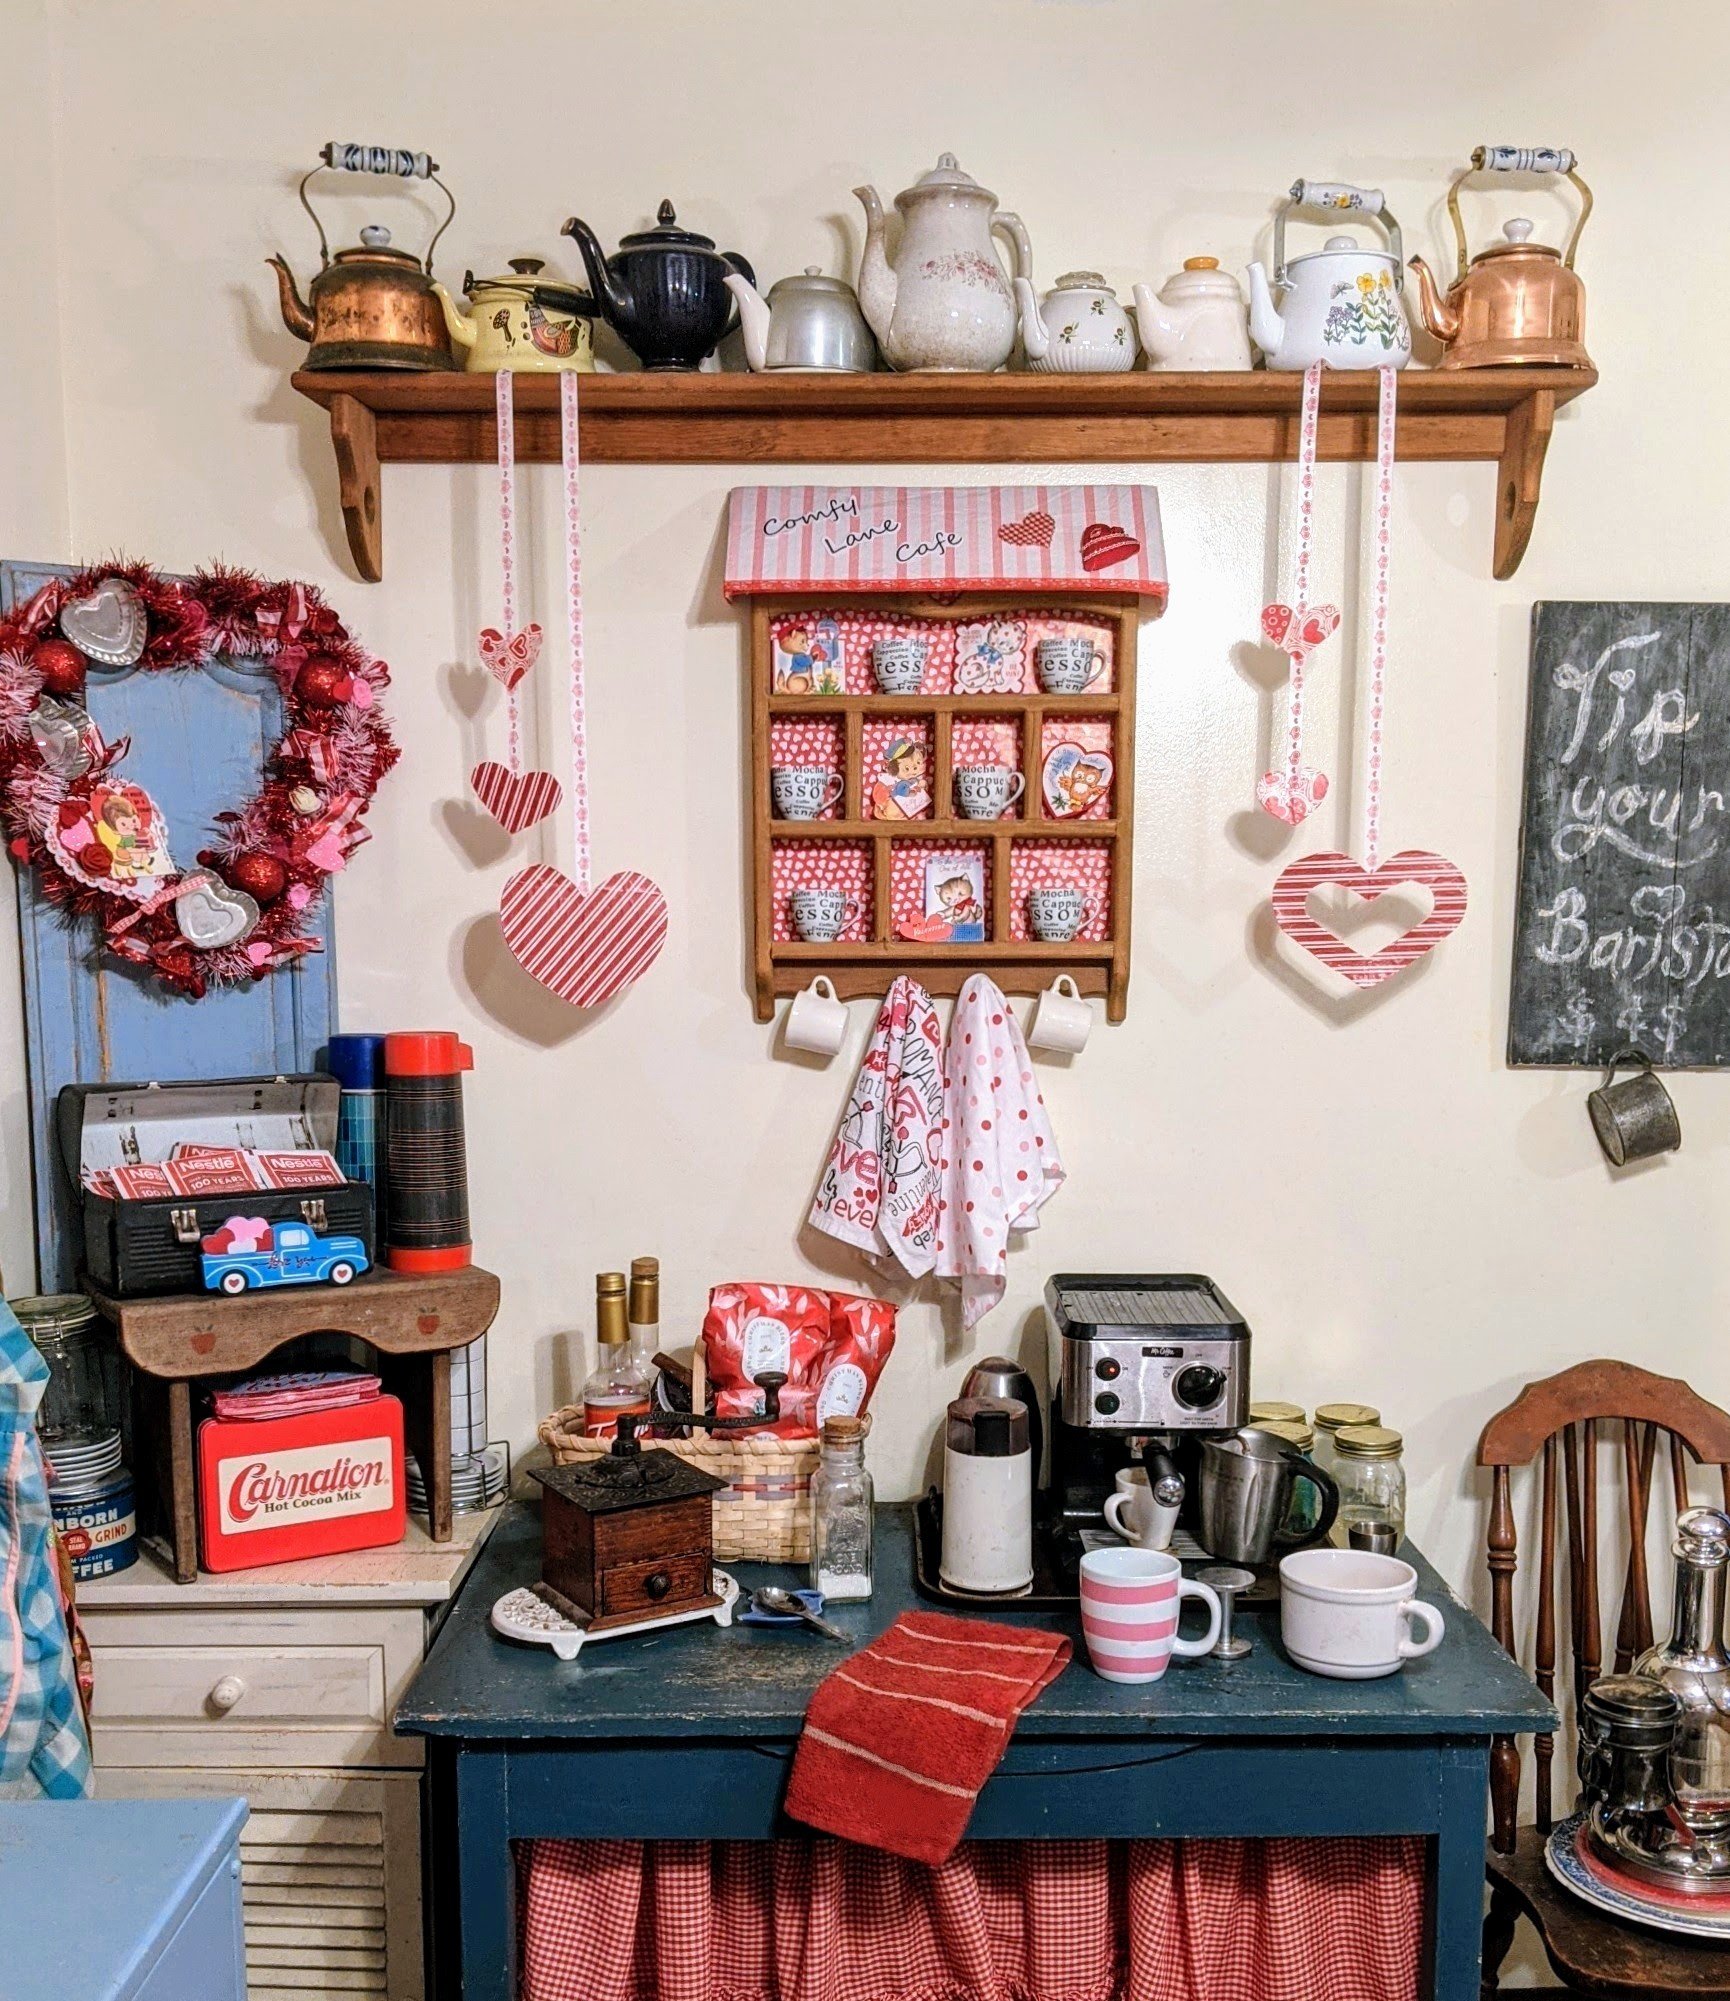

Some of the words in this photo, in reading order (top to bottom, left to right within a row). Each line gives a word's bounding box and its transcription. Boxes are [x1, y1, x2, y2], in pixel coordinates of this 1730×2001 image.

[763, 498, 857, 536] Comfy
[824, 519, 899, 554] Lane
[896, 531, 962, 562] Cafe
[1552, 630, 1700, 765] Tip
[961, 765, 996, 774] Mocha
[1551, 775, 1726, 868] your
[1040, 889, 1075, 898] Mocha
[191, 1178, 211, 1191] 100
[213, 1175, 246, 1186] YEARS
[282, 1176, 301, 1184] 100
[302, 1174, 335, 1184] YEARS
[227, 1457, 384, 1524] Carnation
[264, 1501, 289, 1514] Hot
[293, 1495, 333, 1509] Cocoa
[337, 1489, 362, 1503] Mix
[95, 1523, 127, 1543] GRIND
